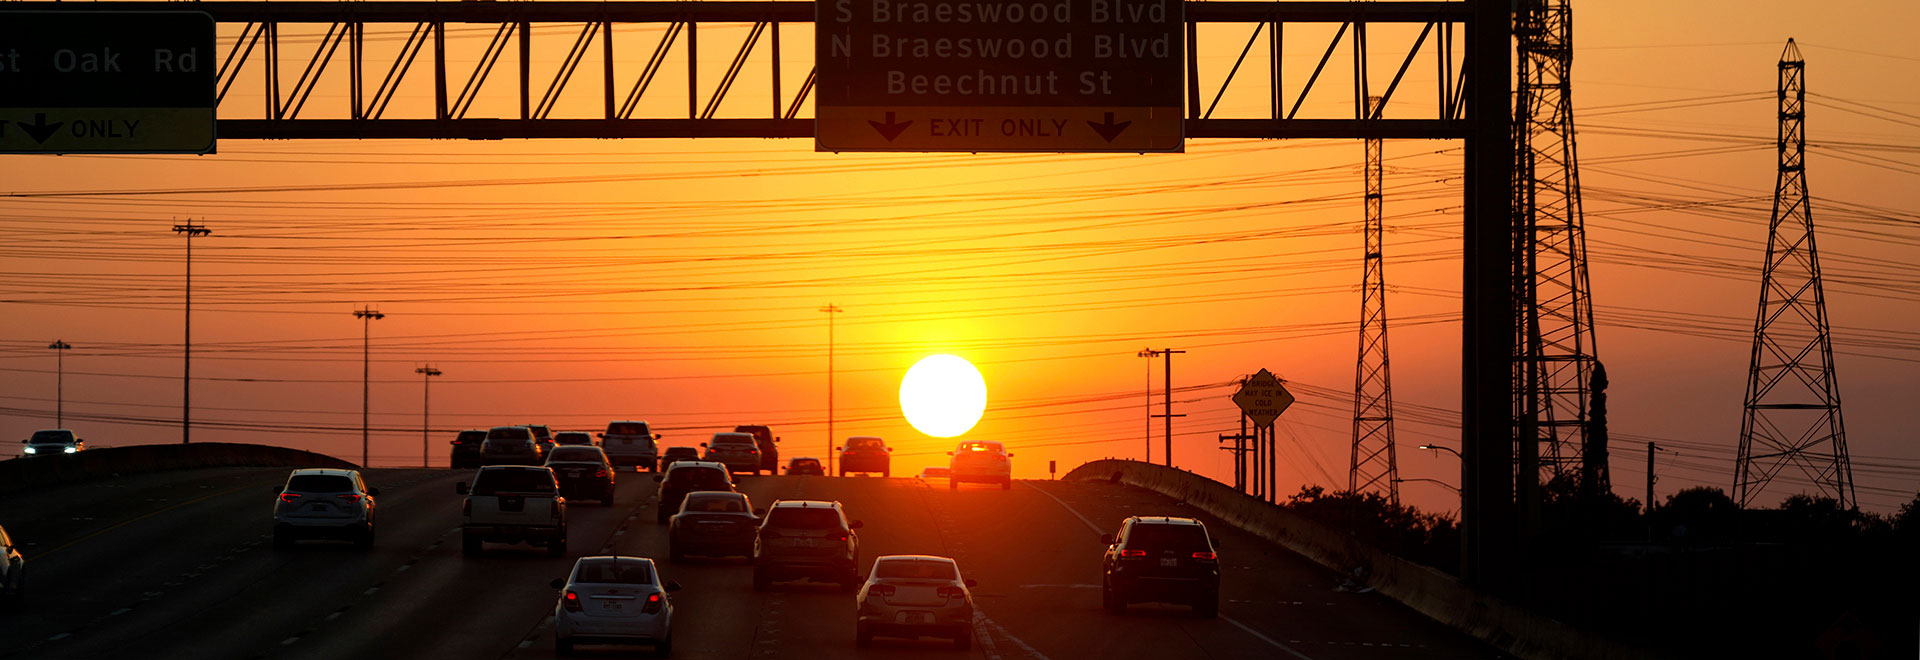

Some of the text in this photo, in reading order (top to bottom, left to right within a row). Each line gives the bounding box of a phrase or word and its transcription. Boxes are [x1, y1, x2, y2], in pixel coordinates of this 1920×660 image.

[836, 0, 1167, 23] S Braeswood Blvd
[831, 33, 1170, 59] N Braeswood Blvd
[53, 47, 122, 73] Oak
[154, 47, 198, 73] Rd
[887, 70, 1112, 95] Beechnut St
[71, 119, 141, 138] ONLY
[930, 118, 1069, 137] EXIT ONLY
[1251, 380, 1275, 388] BRIDGE
[1255, 399, 1272, 407] COLD
